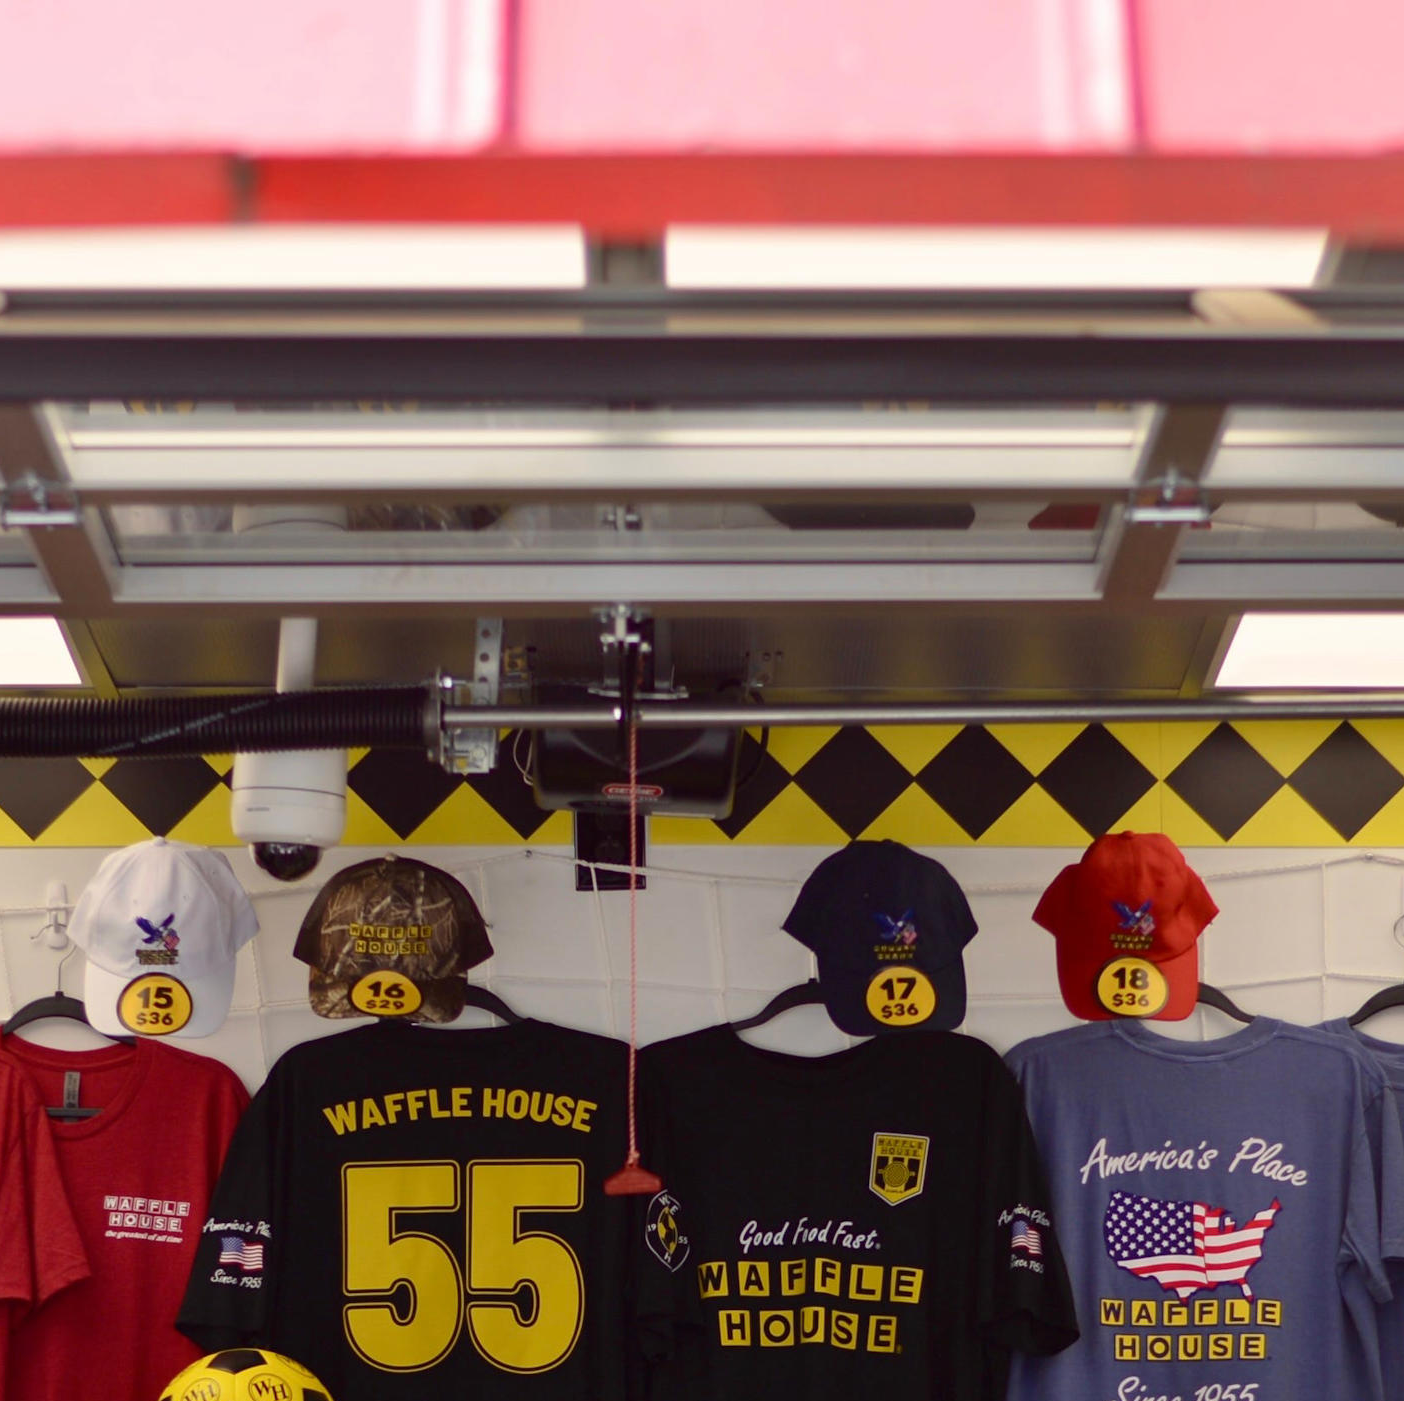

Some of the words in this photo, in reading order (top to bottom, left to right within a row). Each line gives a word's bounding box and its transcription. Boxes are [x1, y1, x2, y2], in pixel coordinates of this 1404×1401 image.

[349, 922, 432, 939] WAFFLE
[355, 939, 428, 955] HOUSE
[880, 978, 916, 1000] 17
[1112, 967, 1149, 990] 18
[137, 987, 173, 1009] 15
[367, 981, 405, 999] 16
[1112, 993, 1149, 1007] $36
[366, 999, 404, 1010] $29
[881, 1003, 919, 1019] $36
[136, 1012, 173, 1025] $36
[322, 1087, 472, 1137] WAFFLE
[483, 1088, 598, 1133] HOUSE
[1079, 1137, 1218, 1187] America's
[1228, 1137, 1308, 1187] Place
[105, 1197, 189, 1216] WAFFLE
[110, 1212, 181, 1231] HOUSE
[739, 1220, 789, 1254] Good
[341, 1158, 586, 1374] 55
[699, 1260, 920, 1300] WAFFLE
[1101, 1301, 1280, 1325] WAFFLE
[724, 1310, 896, 1349] HOUSE
[1116, 1335, 1265, 1360] HOUSE
